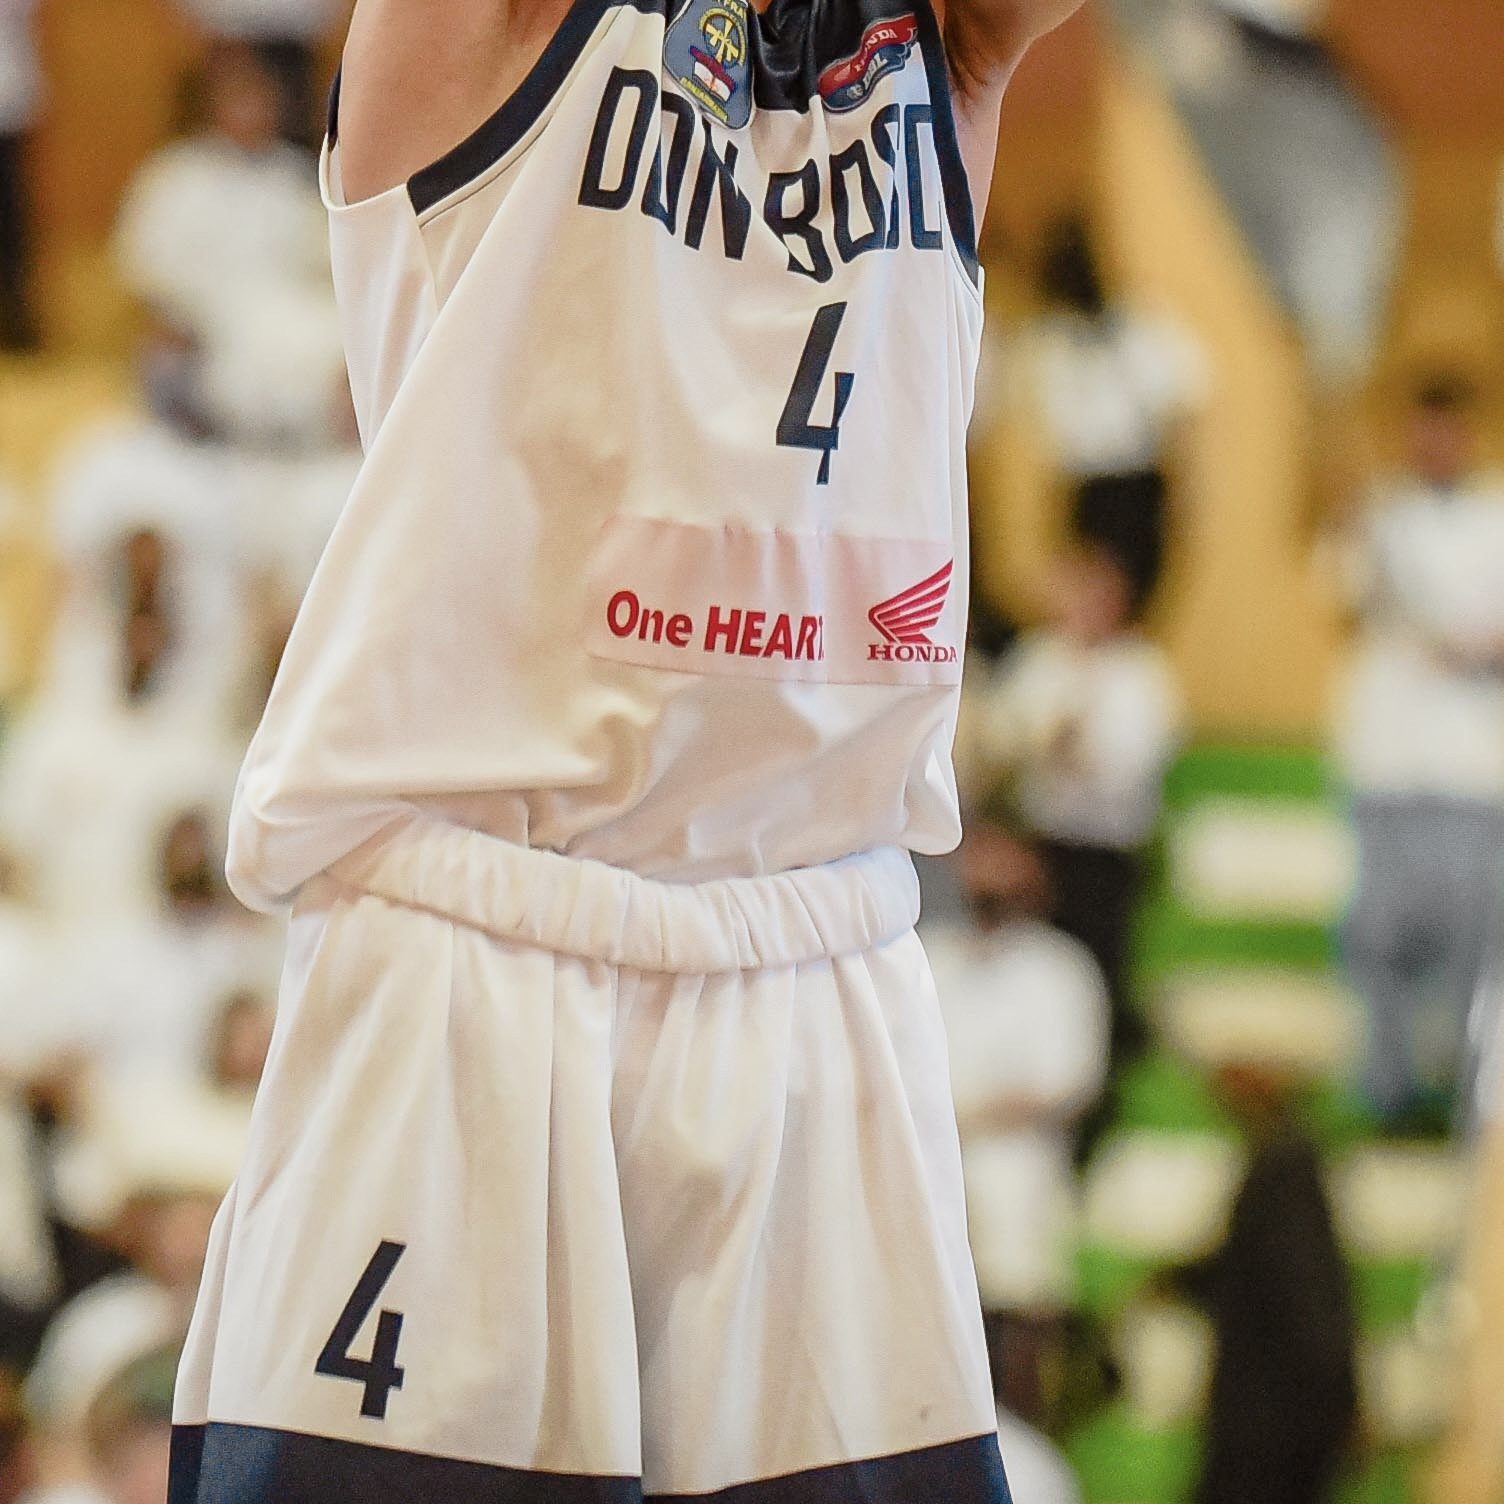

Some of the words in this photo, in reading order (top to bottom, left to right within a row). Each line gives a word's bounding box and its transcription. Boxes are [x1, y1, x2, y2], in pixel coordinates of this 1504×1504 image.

[577, 65, 752, 261] DON
[763, 102, 943, 284] BOSC
[775, 301, 855, 486] 4
[607, 590, 693, 648] One
[867, 643, 958, 664] HONDA
[314, 1238, 407, 1420] 4
